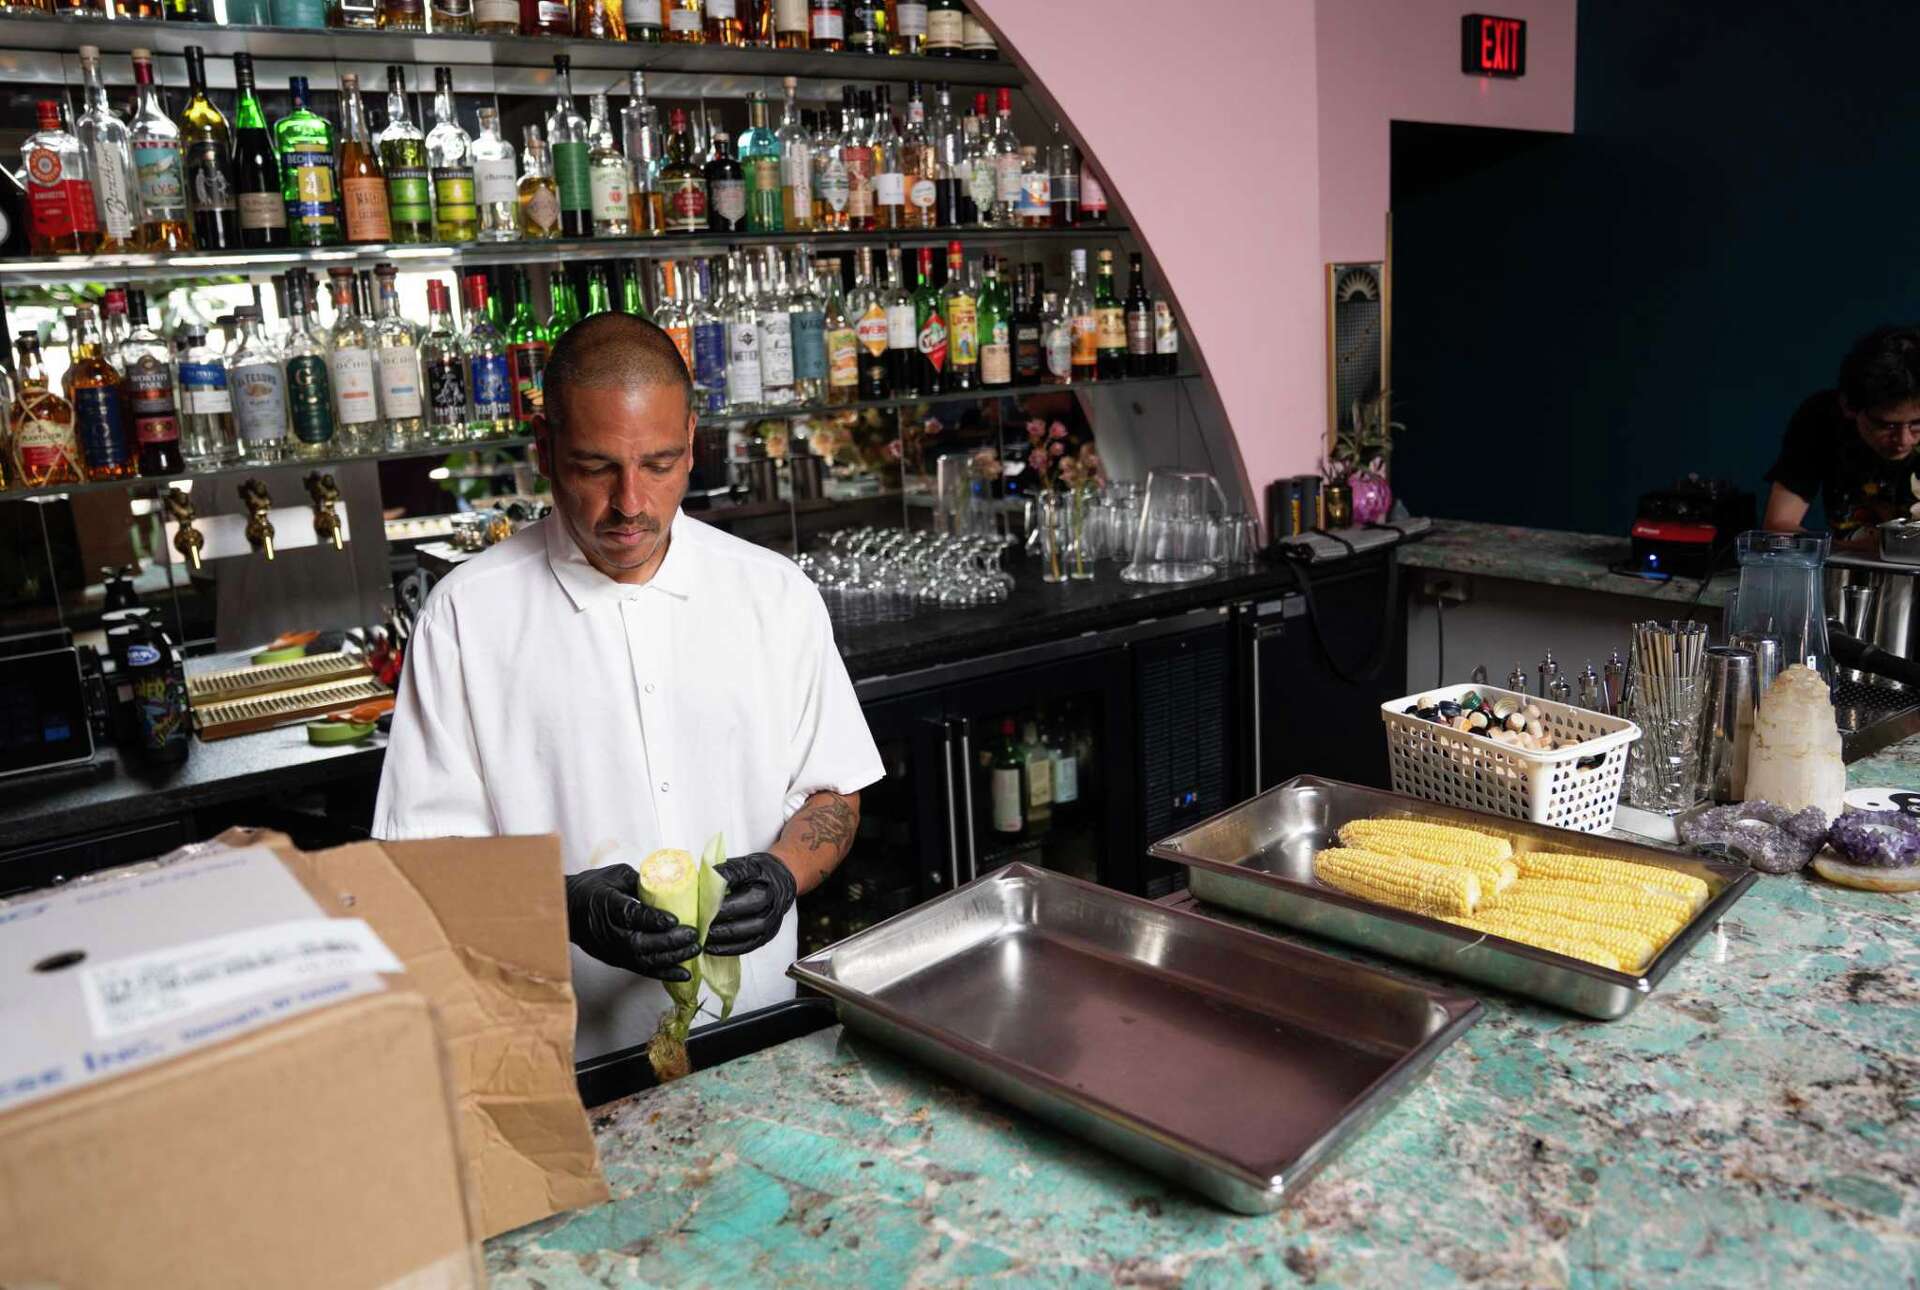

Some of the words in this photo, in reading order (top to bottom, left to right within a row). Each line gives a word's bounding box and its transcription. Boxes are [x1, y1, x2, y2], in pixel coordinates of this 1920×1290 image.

[1481, 18, 1520, 72] EXIT
[131, 373, 169, 383] WORTHY
[139, 380, 163, 390] PARK
